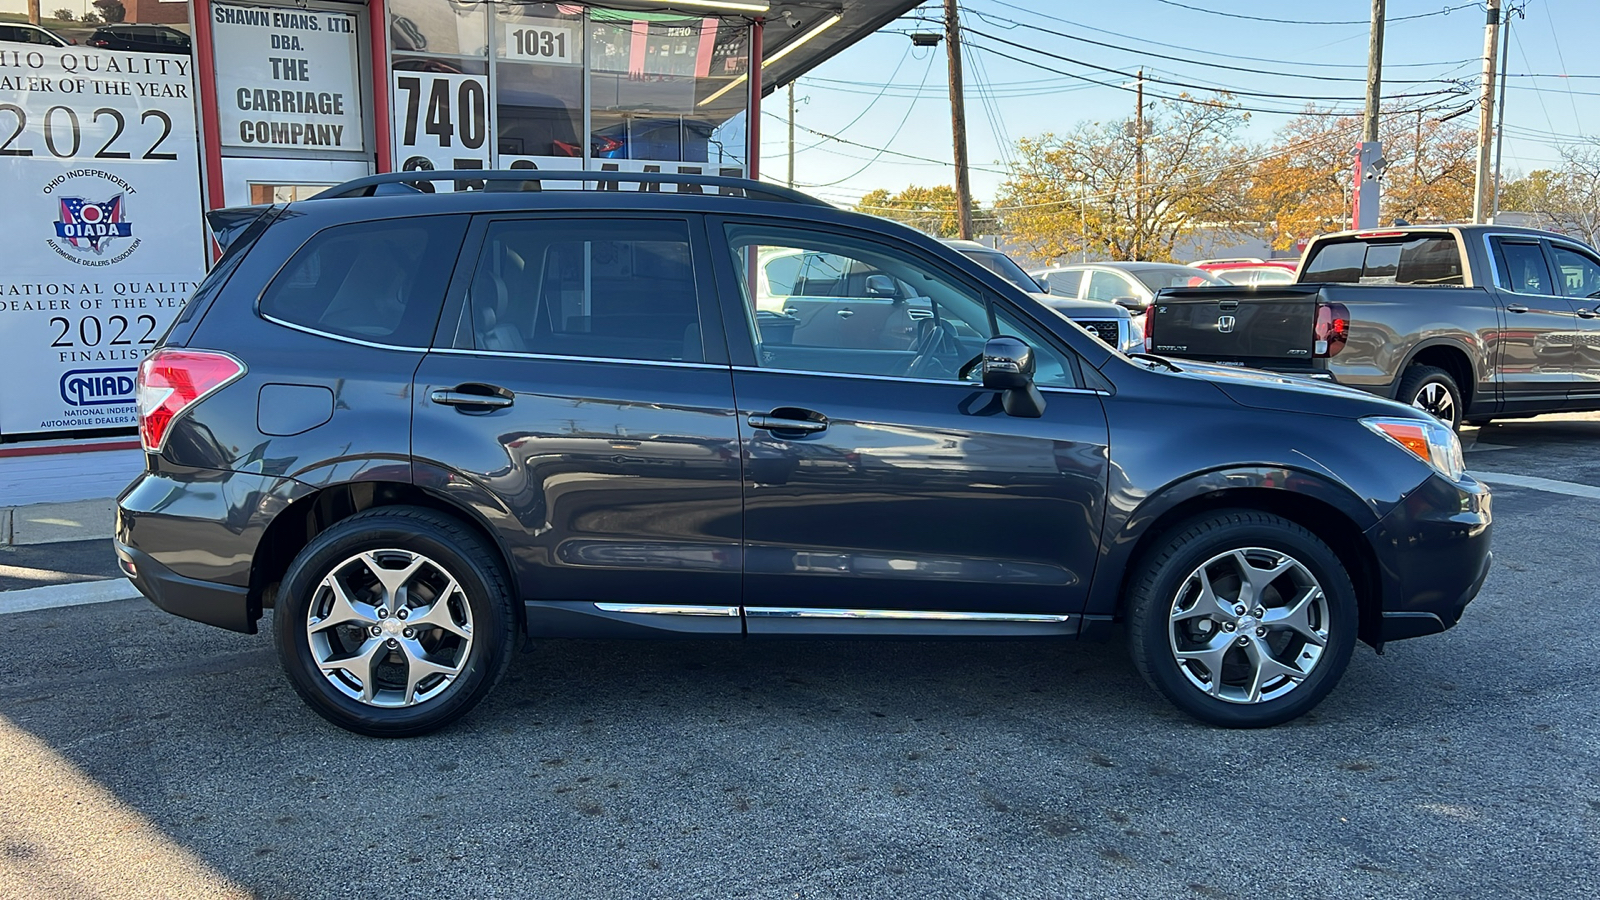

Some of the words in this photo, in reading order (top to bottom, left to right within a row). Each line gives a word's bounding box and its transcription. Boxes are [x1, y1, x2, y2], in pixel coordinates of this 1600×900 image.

[215, 7, 270, 27] SHAWN
[273, 12, 322, 31] EVANS.
[327, 17, 354, 34] LTD.
[270, 34, 304, 51] DBA.
[512, 28, 565, 58] 1031
[60, 53, 189, 76] QUALITY
[268, 57, 310, 82] THE
[58, 78, 86, 94] OF
[90, 80, 132, 96] THE
[136, 82, 189, 99] YEAR
[236, 87, 344, 116] CARRIAGE
[397, 76, 487, 150] 740
[0, 103, 178, 160] 2022
[239, 120, 344, 146] COMPANY
[43, 174, 66, 195] OHIO
[66, 168, 137, 195] INDEPENDENT
[64, 223, 120, 237] OIADA
[46, 238, 81, 265] AUTOMOBILE
[82, 259, 111, 267] DEALERS
[111, 237, 142, 264] ASSOCIATION
[80, 299, 103, 310] OF
[111, 298, 147, 309] THE
[49, 314, 157, 347] 2022
[40, 418, 93, 428] AUTOMOBILE
[95, 416, 129, 425] DEALERS
[64, 408, 104, 417] NATIONAL
